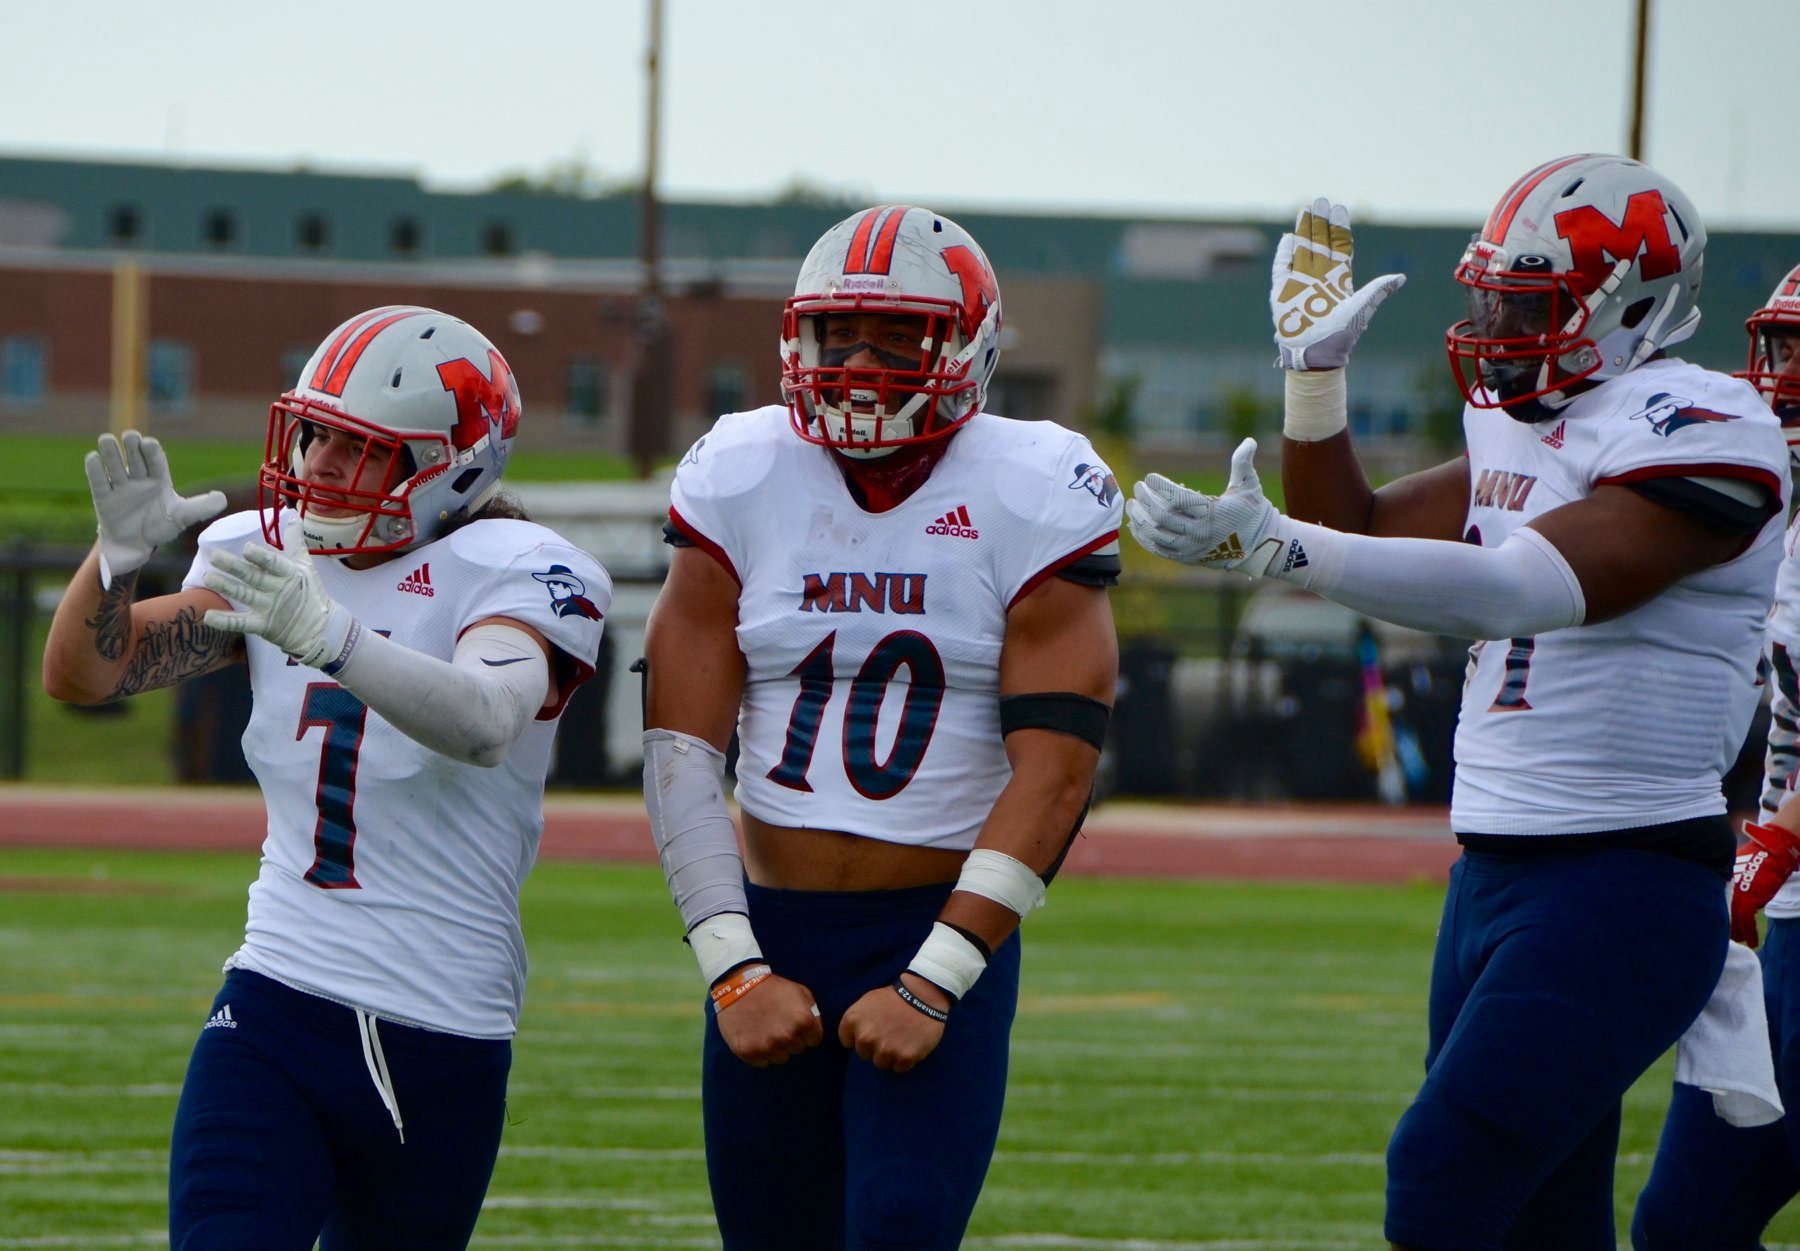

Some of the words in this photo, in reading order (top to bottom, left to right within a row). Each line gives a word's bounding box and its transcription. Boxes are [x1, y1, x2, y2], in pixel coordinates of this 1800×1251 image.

[1553, 188, 1682, 297] M
[842, 278, 884, 290] Riddell
[436, 349, 521, 453] M
[1474, 468, 1538, 513] MNU
[925, 523, 979, 540] adidas
[1282, 538, 1299, 573] adidas
[397, 579, 435, 598] adidas
[797, 571, 929, 616] MNU
[765, 627, 947, 802] 10
[295, 681, 369, 890] 7
[1739, 850, 1769, 893] adidas
